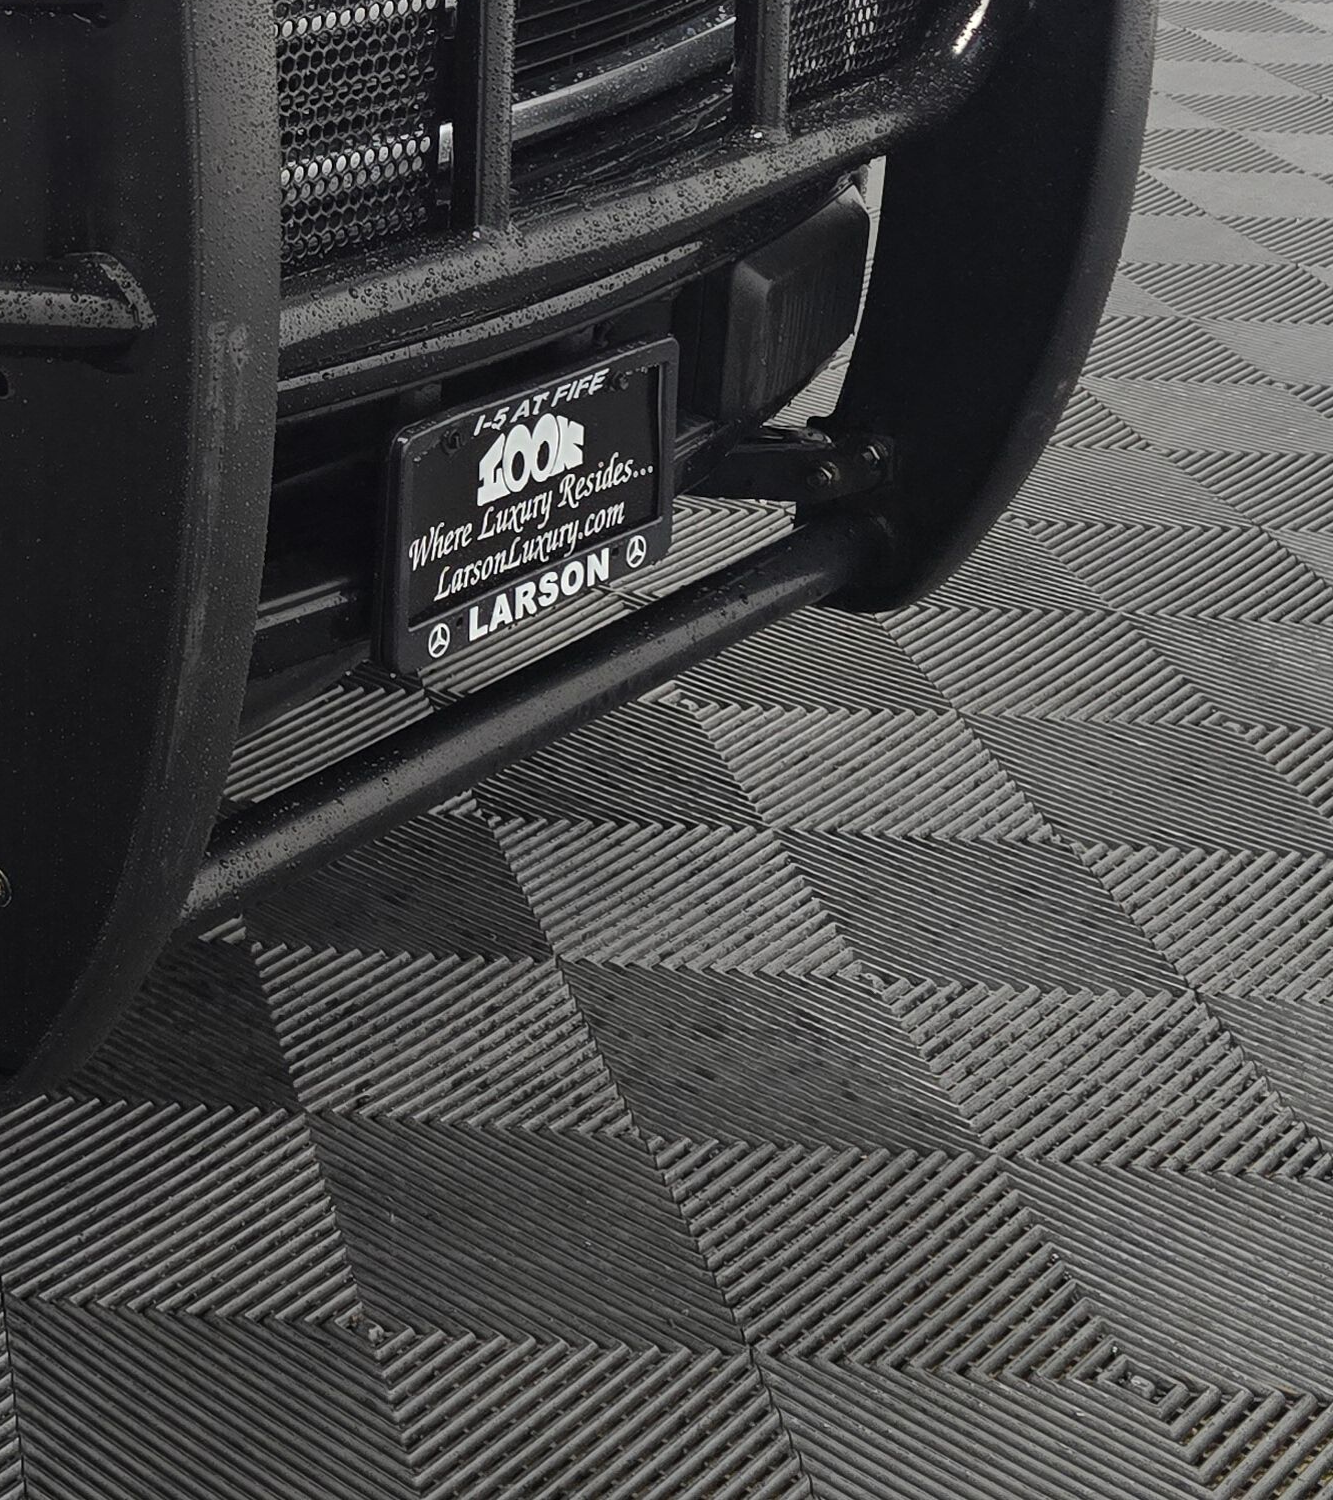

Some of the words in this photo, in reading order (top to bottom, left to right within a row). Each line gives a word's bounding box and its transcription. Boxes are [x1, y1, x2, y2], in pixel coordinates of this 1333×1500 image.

[473, 406, 510, 437] I-5
[509, 391, 550, 423] AT
[550, 368, 610, 408] FIFE
[408, 521, 473, 571] Where
[477, 490, 553, 541] Luxury
[557, 451, 653, 509] Resides...
[433, 501, 625, 602] LarsonLuxury.com
[468, 547, 610, 642] LARSON
